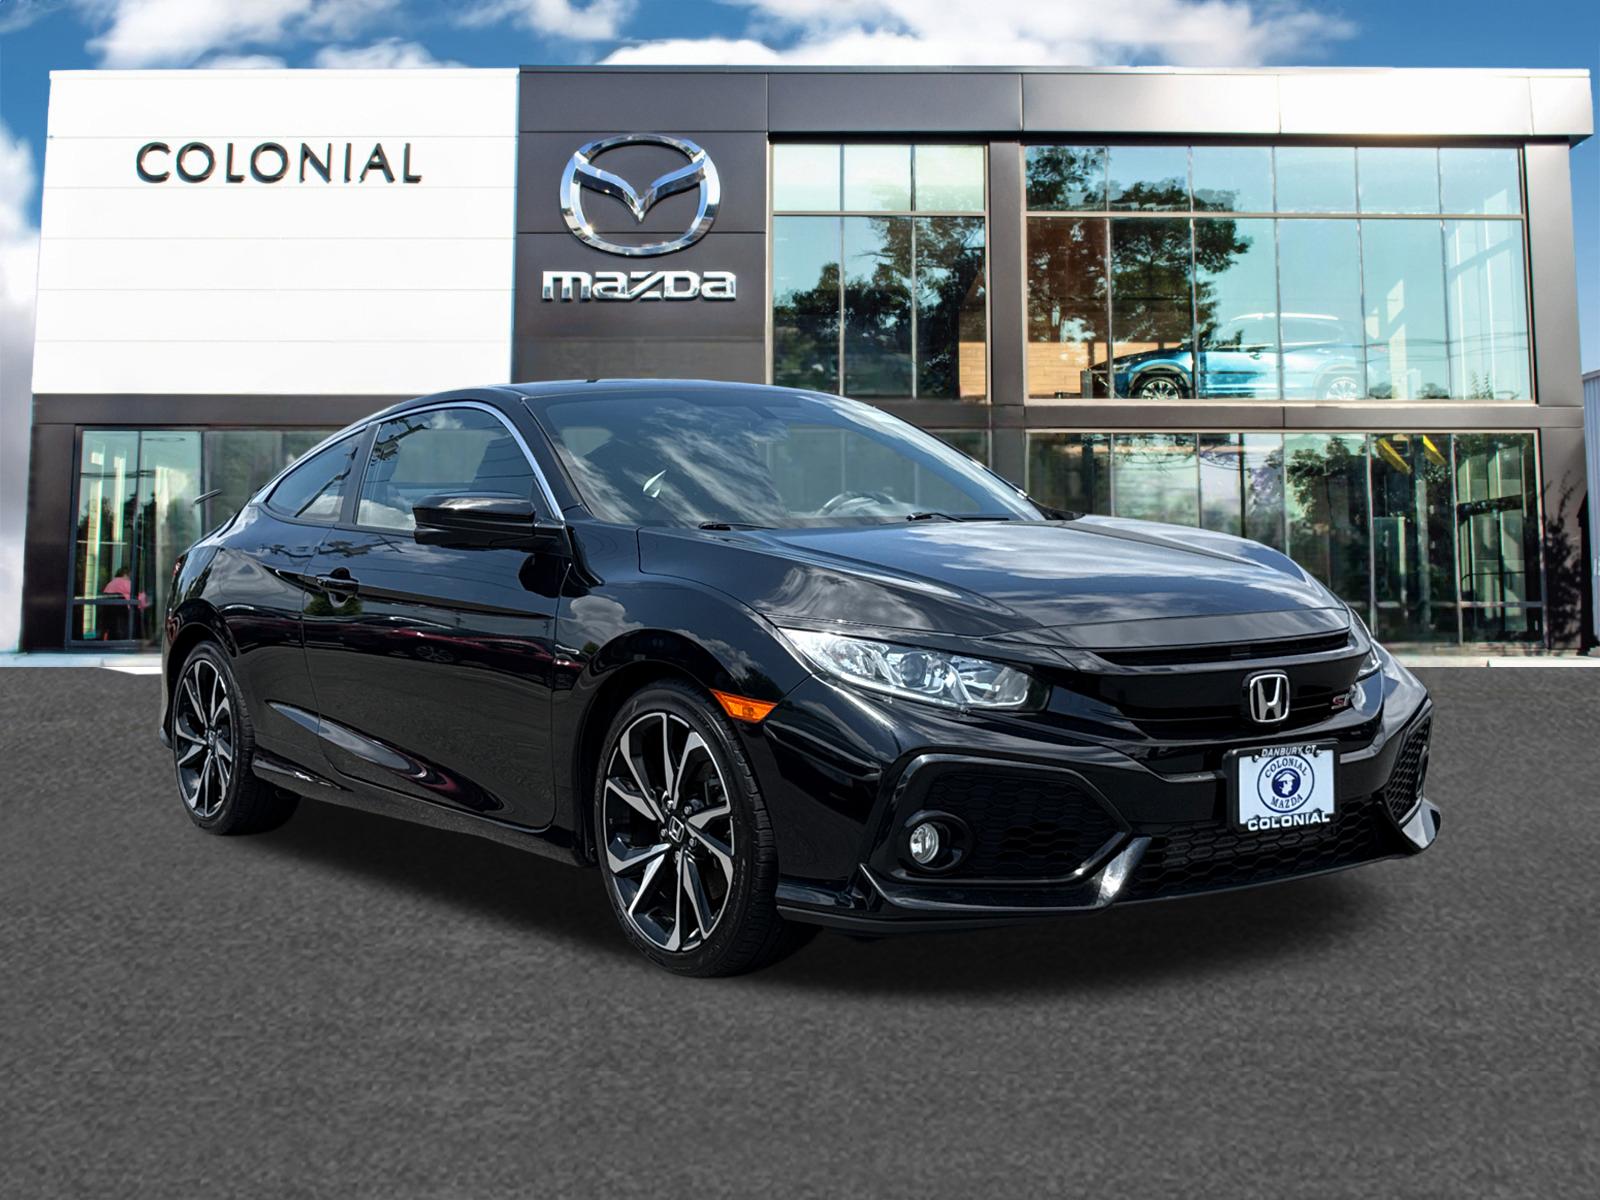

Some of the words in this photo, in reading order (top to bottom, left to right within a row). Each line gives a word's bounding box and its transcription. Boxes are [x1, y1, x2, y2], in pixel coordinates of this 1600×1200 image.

[136, 142, 422, 183] COLONIAL
[1261, 746, 1303, 757] DANBURY
[1264, 757, 1308, 778] COLONIAL
[1270, 794, 1303, 809] MAZDA
[1247, 812, 1330, 831] COLONIAL
